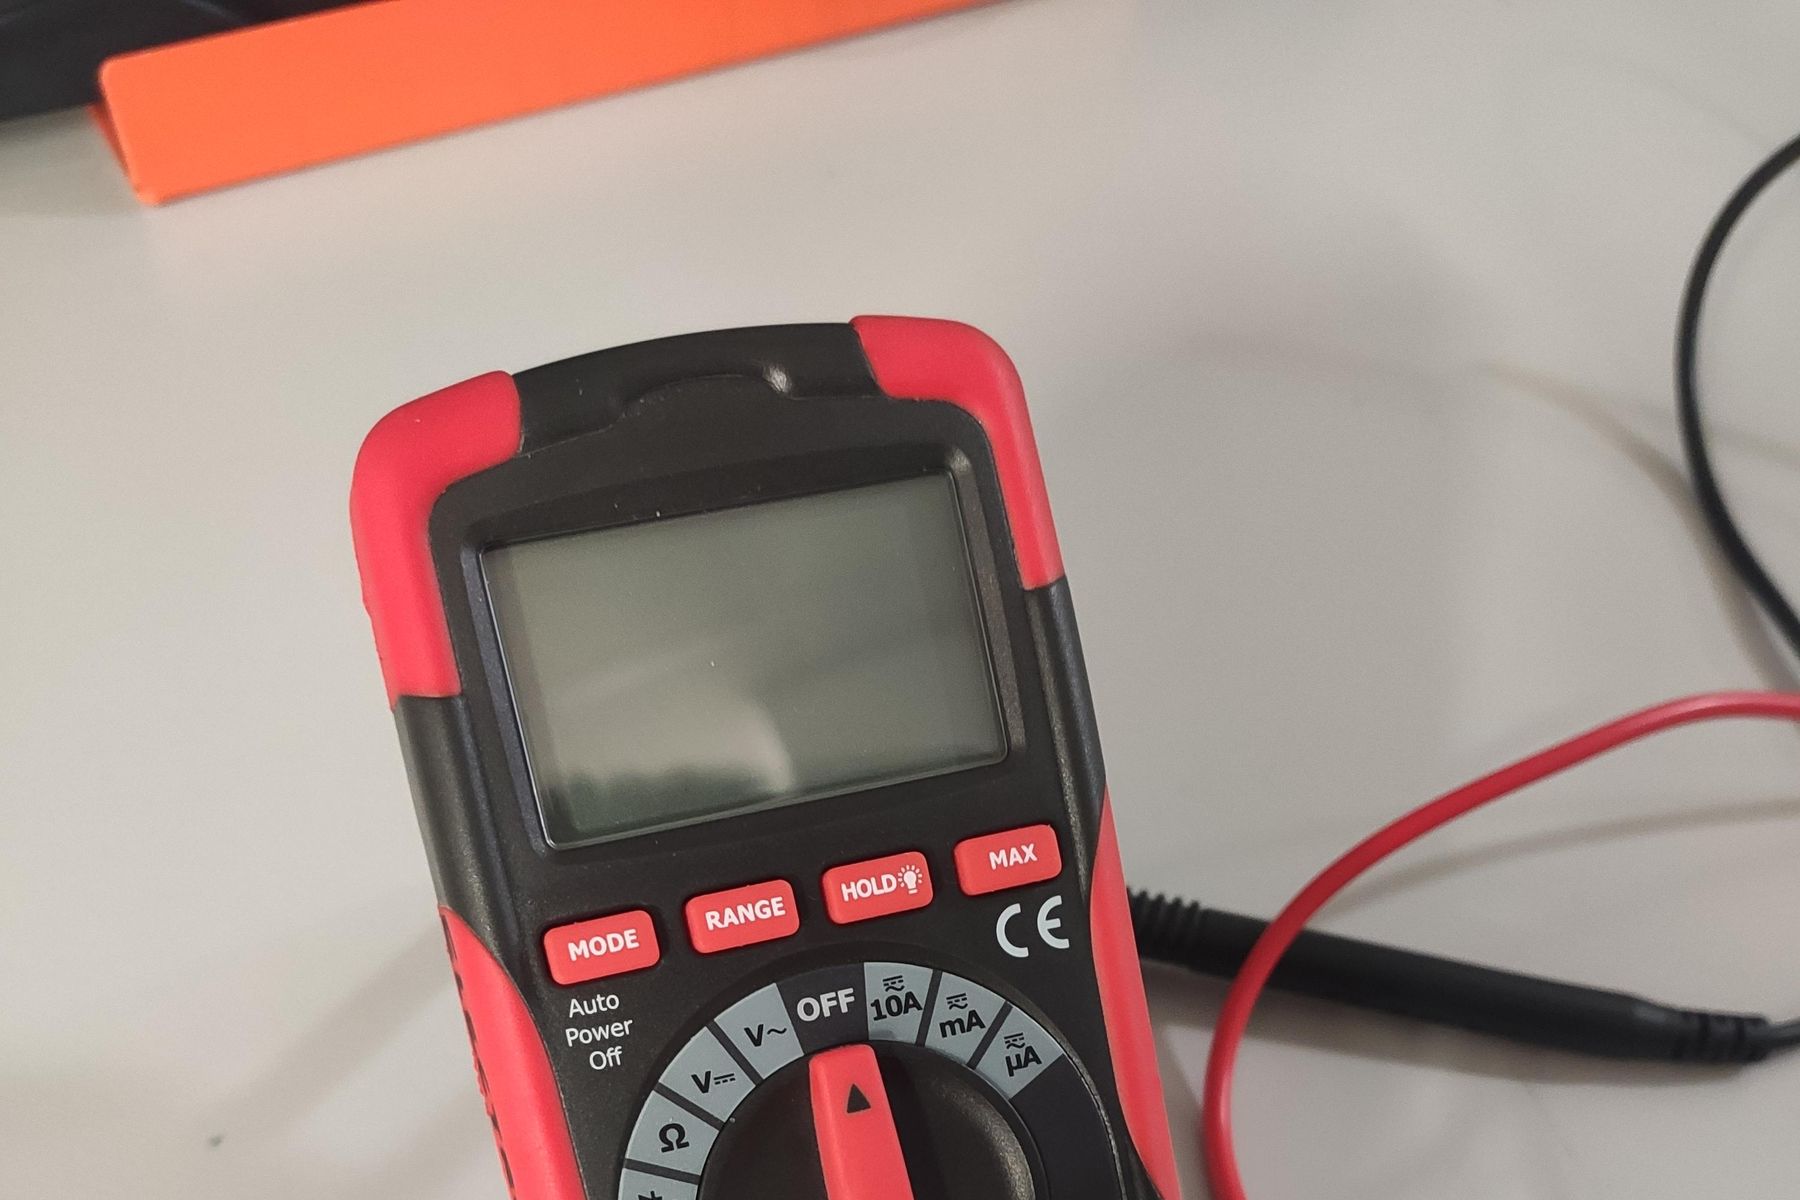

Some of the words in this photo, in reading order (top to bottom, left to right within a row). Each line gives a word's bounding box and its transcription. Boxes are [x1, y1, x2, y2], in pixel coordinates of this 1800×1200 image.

[989, 843, 1038, 870] MAX
[841, 873, 897, 902] HOLD
[705, 896, 786, 931] RANGE
[567, 928, 640, 961] MODE
[568, 994, 620, 1018] Auto
[797, 988, 855, 1022] OFF
[870, 991, 923, 1021] 10A
[565, 1019, 633, 1047] Power
[939, 1009, 985, 1038] mA
[589, 1046, 624, 1070] Off
